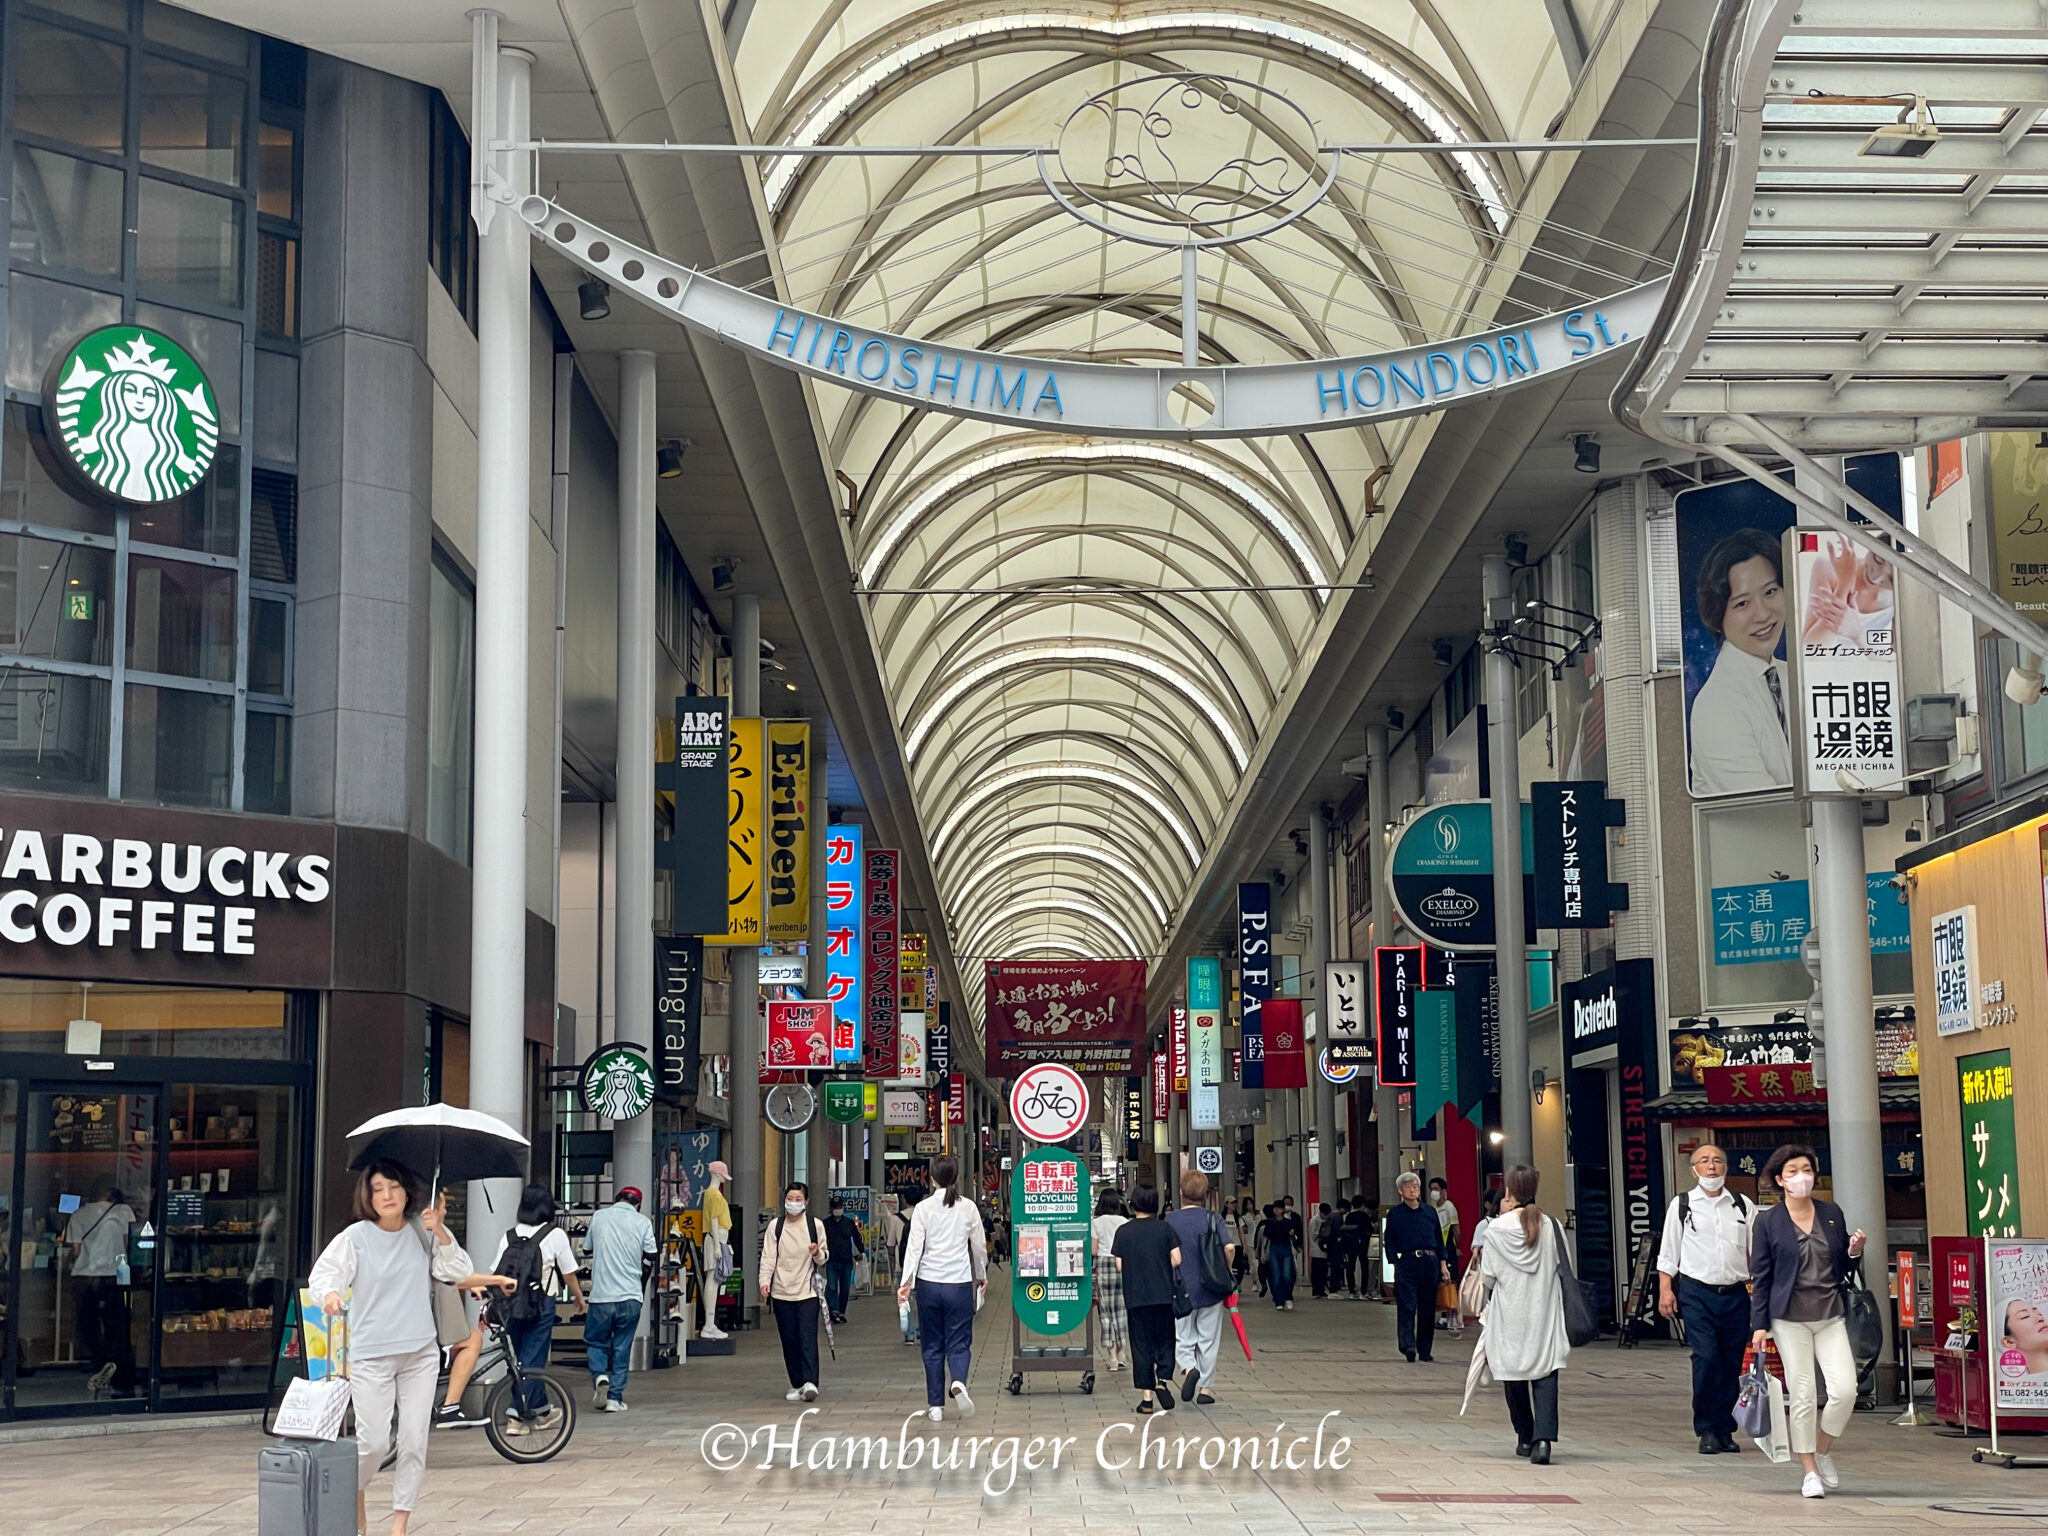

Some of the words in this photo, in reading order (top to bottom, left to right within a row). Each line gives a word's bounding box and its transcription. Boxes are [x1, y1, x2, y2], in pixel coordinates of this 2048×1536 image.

[767, 309, 1064, 415] HIROSHIMA
[1317, 330, 1539, 413] HONDORI
[1564, 311, 1629, 357] St.
[2015, 602, 2048, 612] Beaut
[1872, 632, 1888, 643] 2F
[681, 712, 722, 731] ABC
[681, 732, 722, 746] MART
[681, 752, 717, 760] GRAND
[681, 760, 714, 768] STAGE
[771, 740, 805, 907] Eriben
[0, 828, 330, 902] ARBUCKS
[1561, 789, 1582, 918] ストレッチ専門店
[1428, 900, 1473, 910] EXELCO
[1717, 889, 1774, 915] 本通
[0, 889, 255, 955] COFFEE
[1719, 917, 1807, 945] 不動産
[1396, 953, 1408, 1017] PARIS
[1489, 976, 1498, 1018] EXELCO
[659, 950, 696, 1084] ringram
[776, 1005, 825, 1023] JUMP
[1334, 973, 1357, 1035] いとや
[787, 1020, 813, 1028] SHOP
[1174, 1008, 1186, 1077] サンドラッグ
[1397, 1027, 1409, 1077] MIKI
[901, 1102, 919, 1112] TCB
[1129, 1091, 1140, 1140] BEAMS
[1623, 1065, 1648, 1180] STRETCH
[889, 1164, 930, 1188] SHACK
[1024, 1161, 1077, 1179] 自転車
[1024, 1180, 1078, 1193] 通行禁止
[1025, 1194, 1038, 1202] NO
[1039, 1194, 1077, 1202] CYCLING
